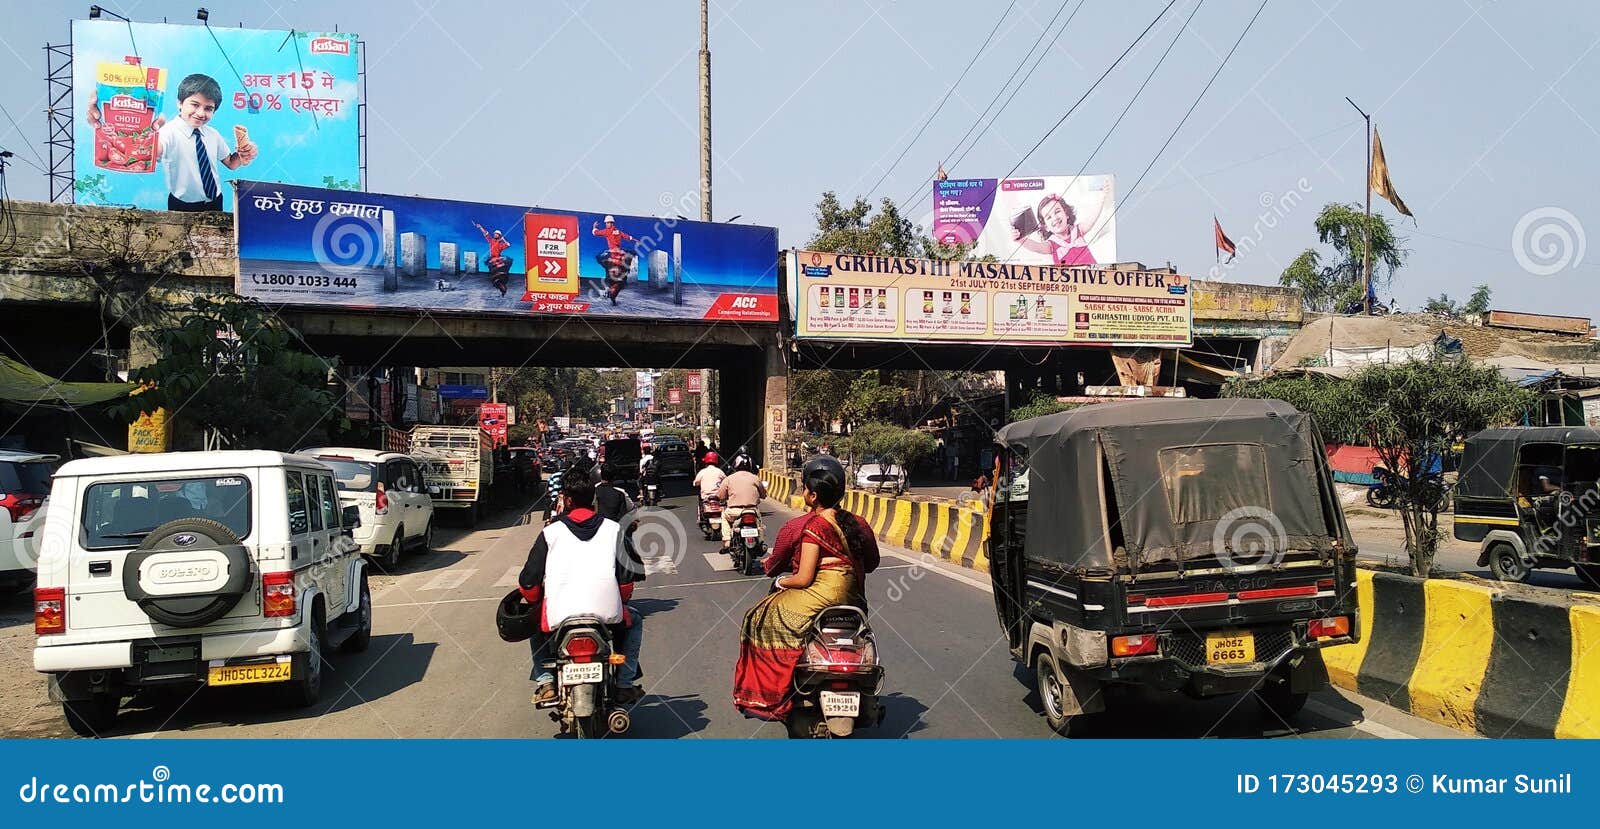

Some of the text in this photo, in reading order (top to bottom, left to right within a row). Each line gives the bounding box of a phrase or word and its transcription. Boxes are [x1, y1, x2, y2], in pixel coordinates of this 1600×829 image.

[243, 74, 272, 87] अब
[233, 92, 282, 110] 50%
[115, 115, 140, 123] CHOTU
[253, 192, 384, 220] करें कुछ कमाल
[537, 228, 567, 240] ACC
[835, 254, 950, 277] GRIHASTHI
[959, 262, 1032, 280] MASALA
[1040, 267, 1108, 285] FESTIVE
[1114, 271, 1166, 288] OFFER
[261, 274, 357, 288] 1800 1033 444
[950, 278, 1078, 293] 21st JULY TO 21st SEPTEMBER 2019
[732, 297, 757, 308] ACC
[1091, 313, 1130, 321] GRIHASTHI
[160, 568, 209, 578] BOLERO
[1194, 579, 1268, 592] PIAGGIO
[1215, 640, 1243, 649] JH05Z
[1213, 650, 1245, 660] 6663
[218, 666, 289, 681] JH05CL3224
